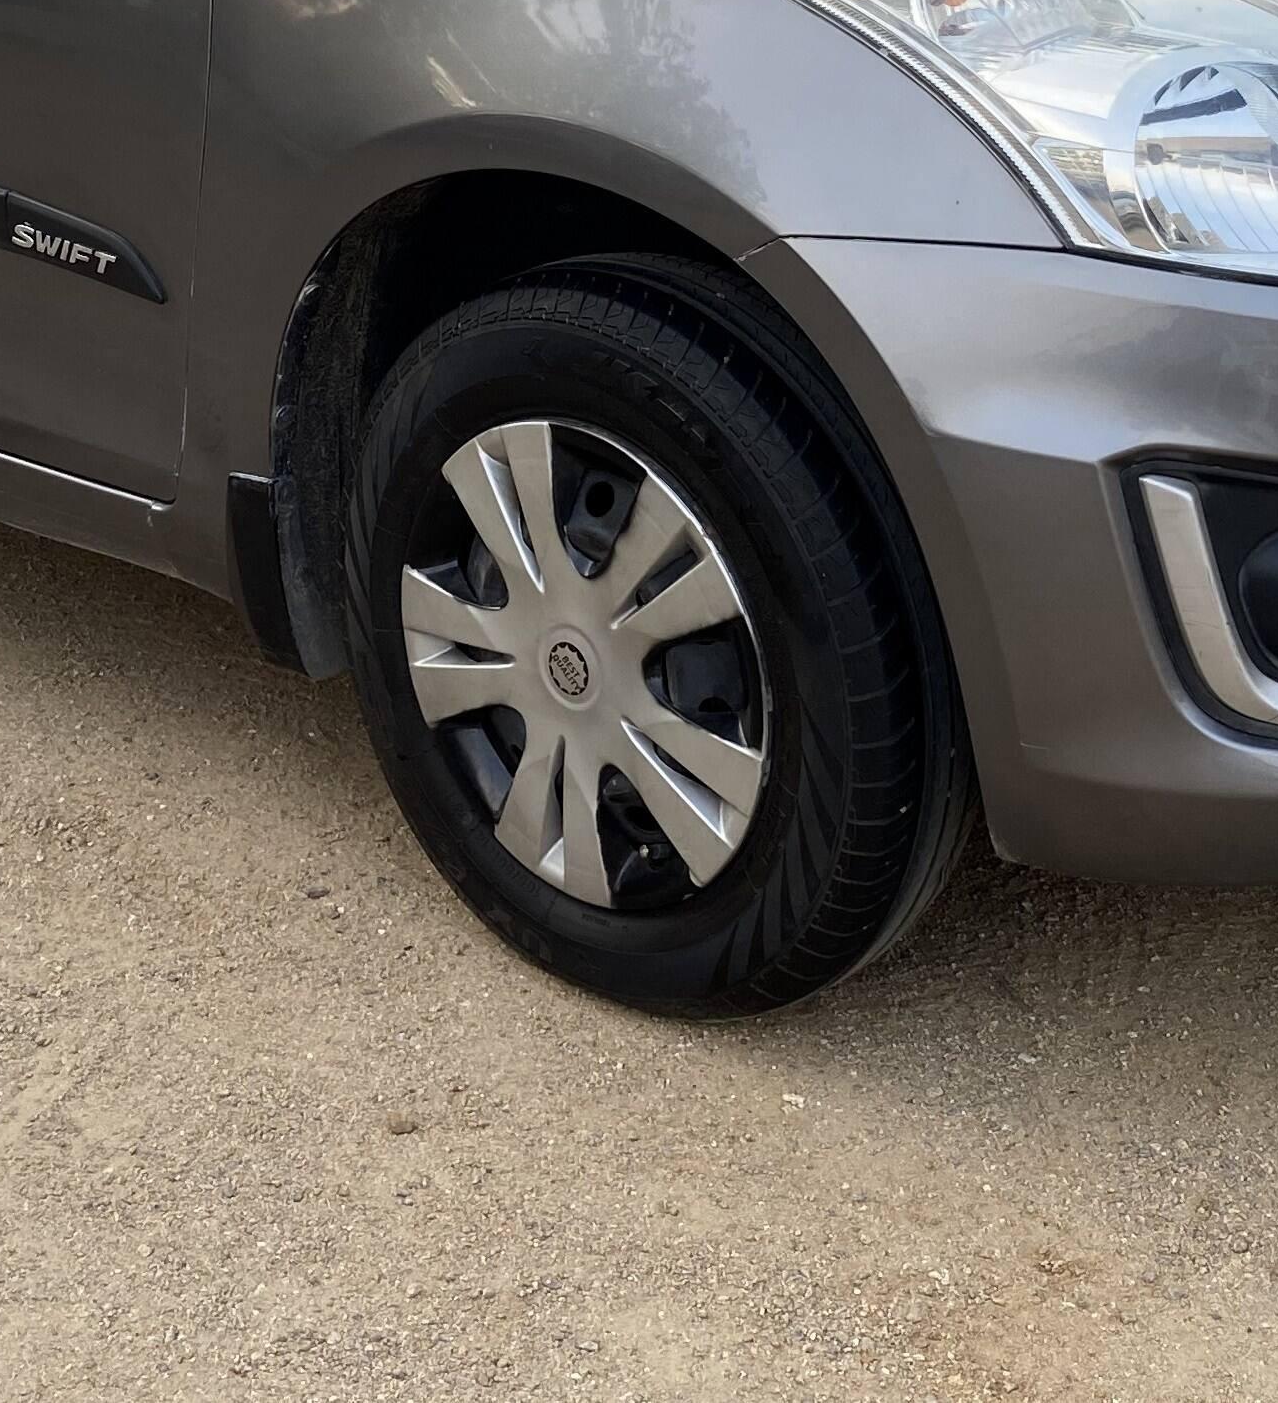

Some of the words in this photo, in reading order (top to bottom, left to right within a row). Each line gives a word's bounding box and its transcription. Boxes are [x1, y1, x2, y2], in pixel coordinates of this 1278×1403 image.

[11, 221, 118, 275] SWIFT
[552, 654, 580, 690] QUALITY
[562, 655, 580, 678] BEST
